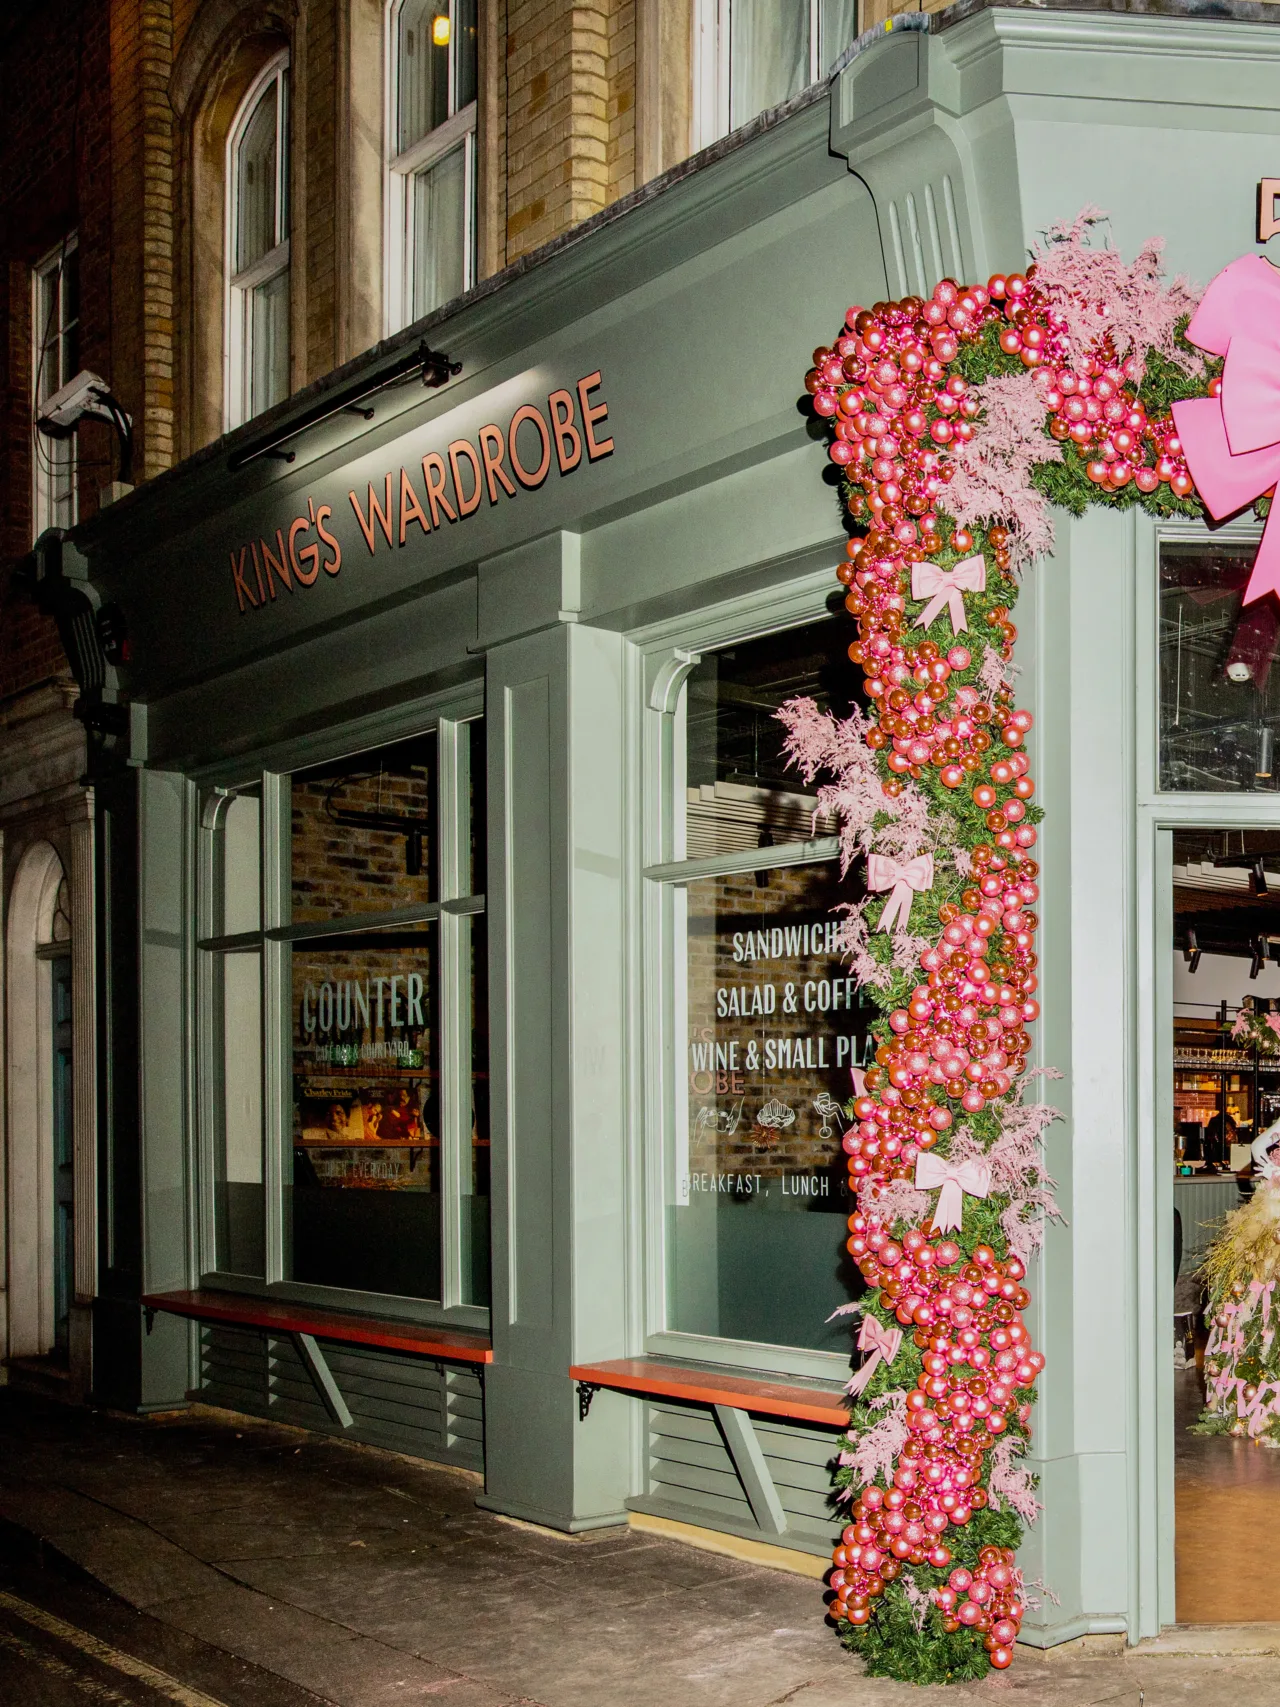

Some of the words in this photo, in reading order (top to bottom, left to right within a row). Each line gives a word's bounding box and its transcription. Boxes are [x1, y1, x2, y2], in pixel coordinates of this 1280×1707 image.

[229, 496, 342, 613] KING'S
[348, 369, 615, 558] WARDROBE
[303, 972, 425, 1033] COUNTER
[716, 983, 776, 1018] SALAD
[782, 981, 798, 1014] &
[691, 1041, 740, 1072] WINE
[745, 1039, 760, 1071] &
[765, 1037, 830, 1070] SMALL
[782, 1175, 829, 1197] LUNCH
